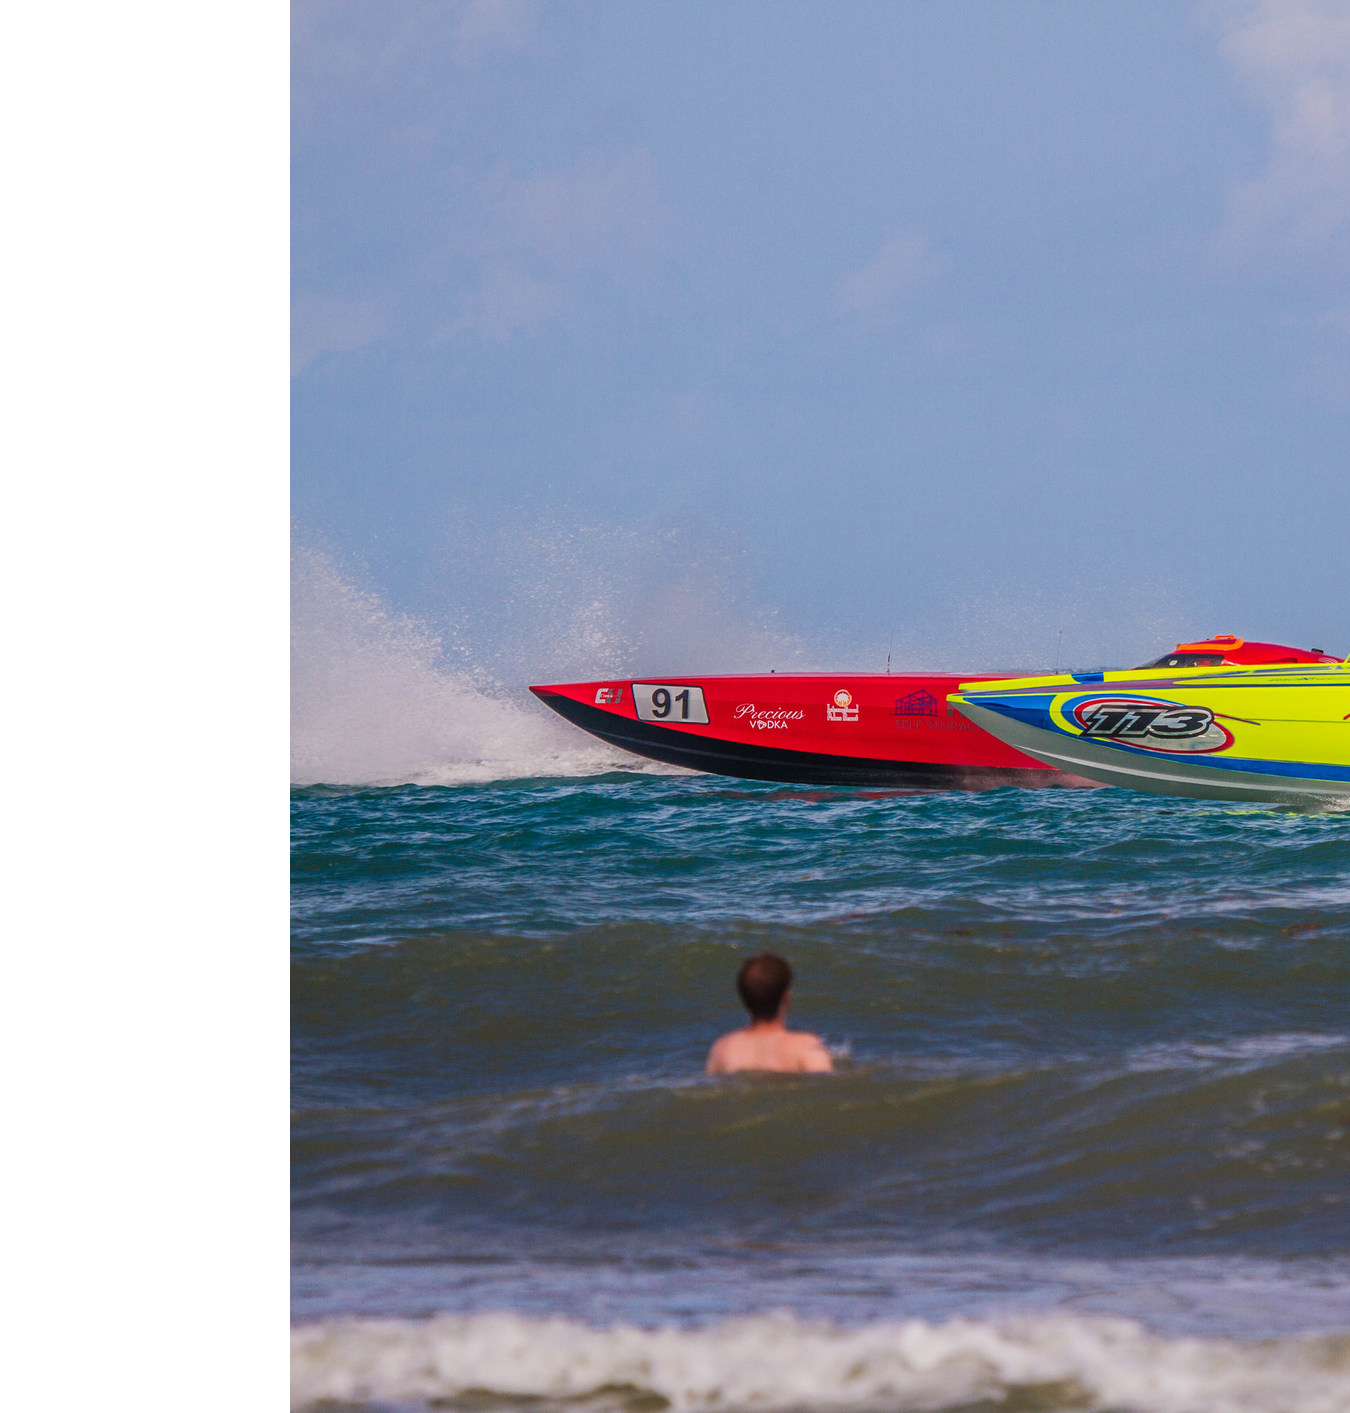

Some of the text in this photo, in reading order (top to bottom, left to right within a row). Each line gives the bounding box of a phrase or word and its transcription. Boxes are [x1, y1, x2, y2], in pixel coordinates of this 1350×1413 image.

[651, 688, 690, 719] 91
[733, 703, 806, 719] Precious
[1082, 704, 1214, 739] 113
